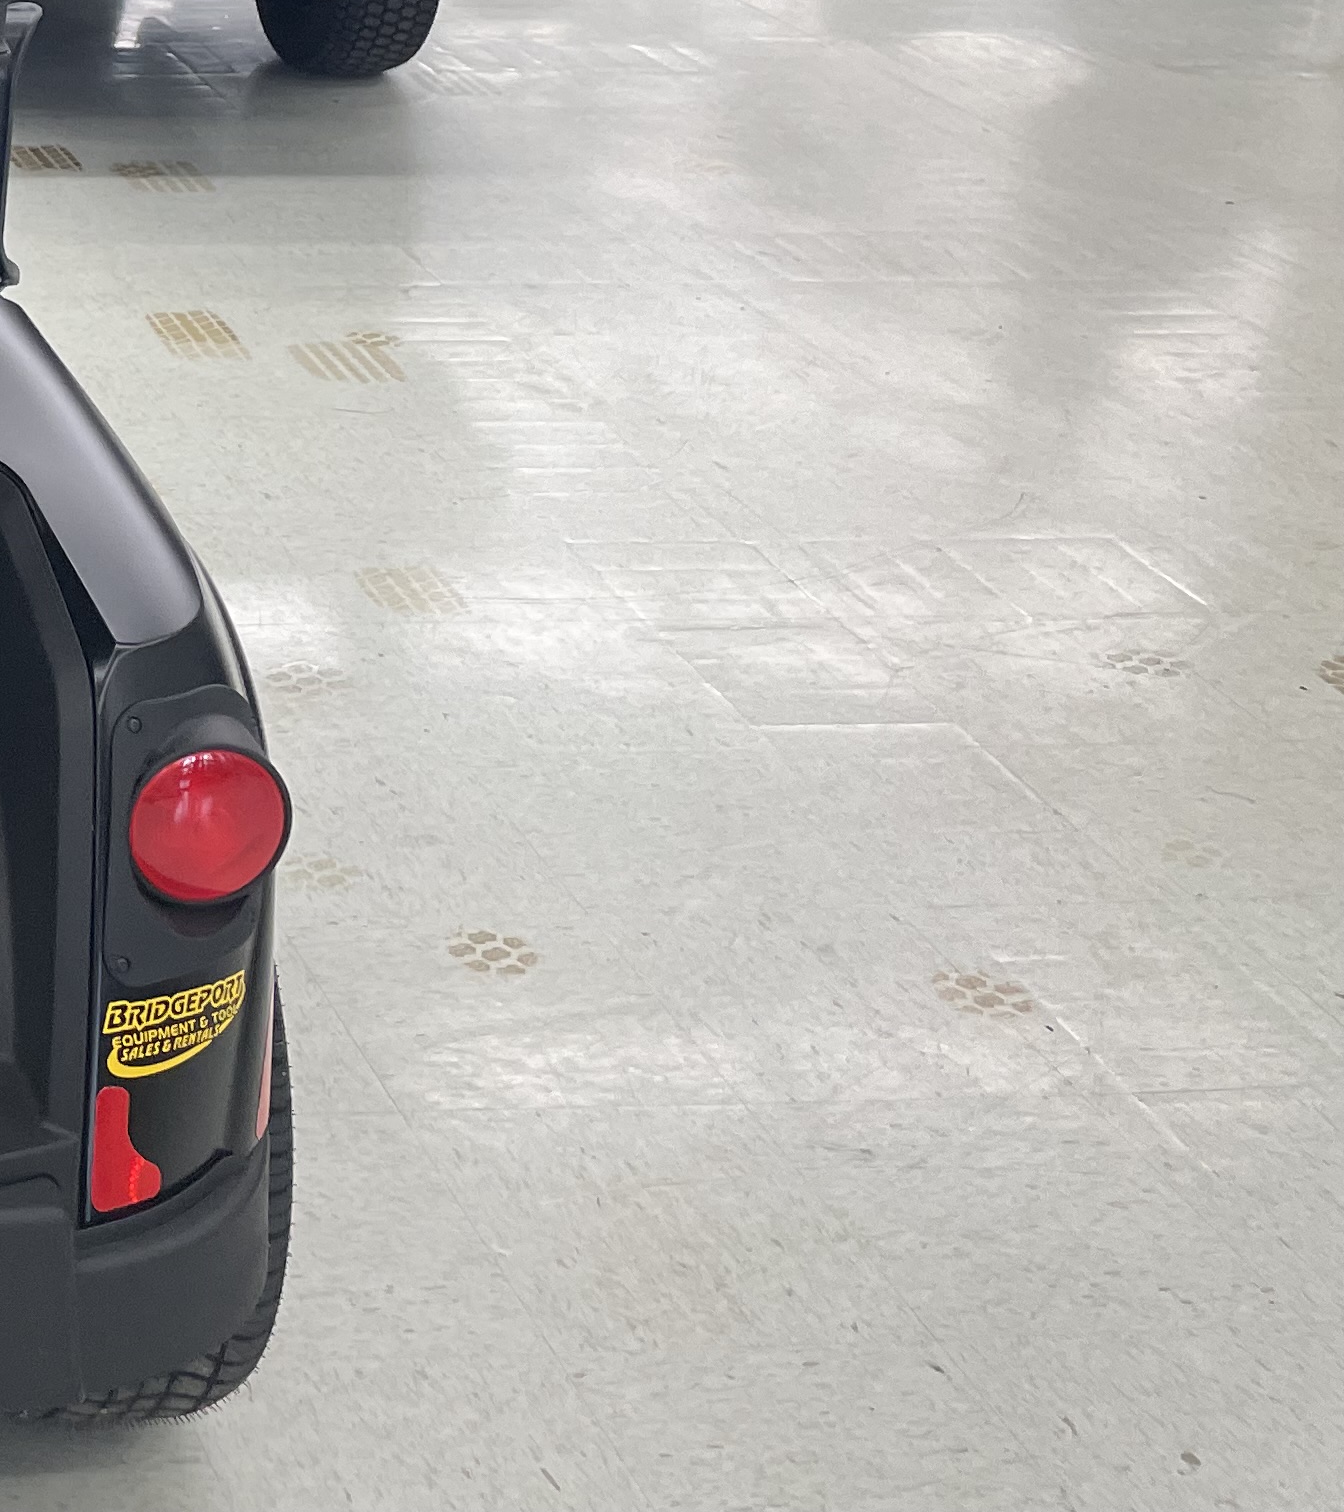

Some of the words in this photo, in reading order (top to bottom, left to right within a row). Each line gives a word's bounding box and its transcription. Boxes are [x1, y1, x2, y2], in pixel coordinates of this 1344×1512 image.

[105, 972, 244, 1031] BRIDGEPORT
[112, 1019, 196, 1048] EQUIPMENT
[200, 1016, 208, 1029] &
[120, 1041, 160, 1062] SALES
[162, 1040, 171, 1053] &
[173, 1024, 220, 1051] RENTALS
